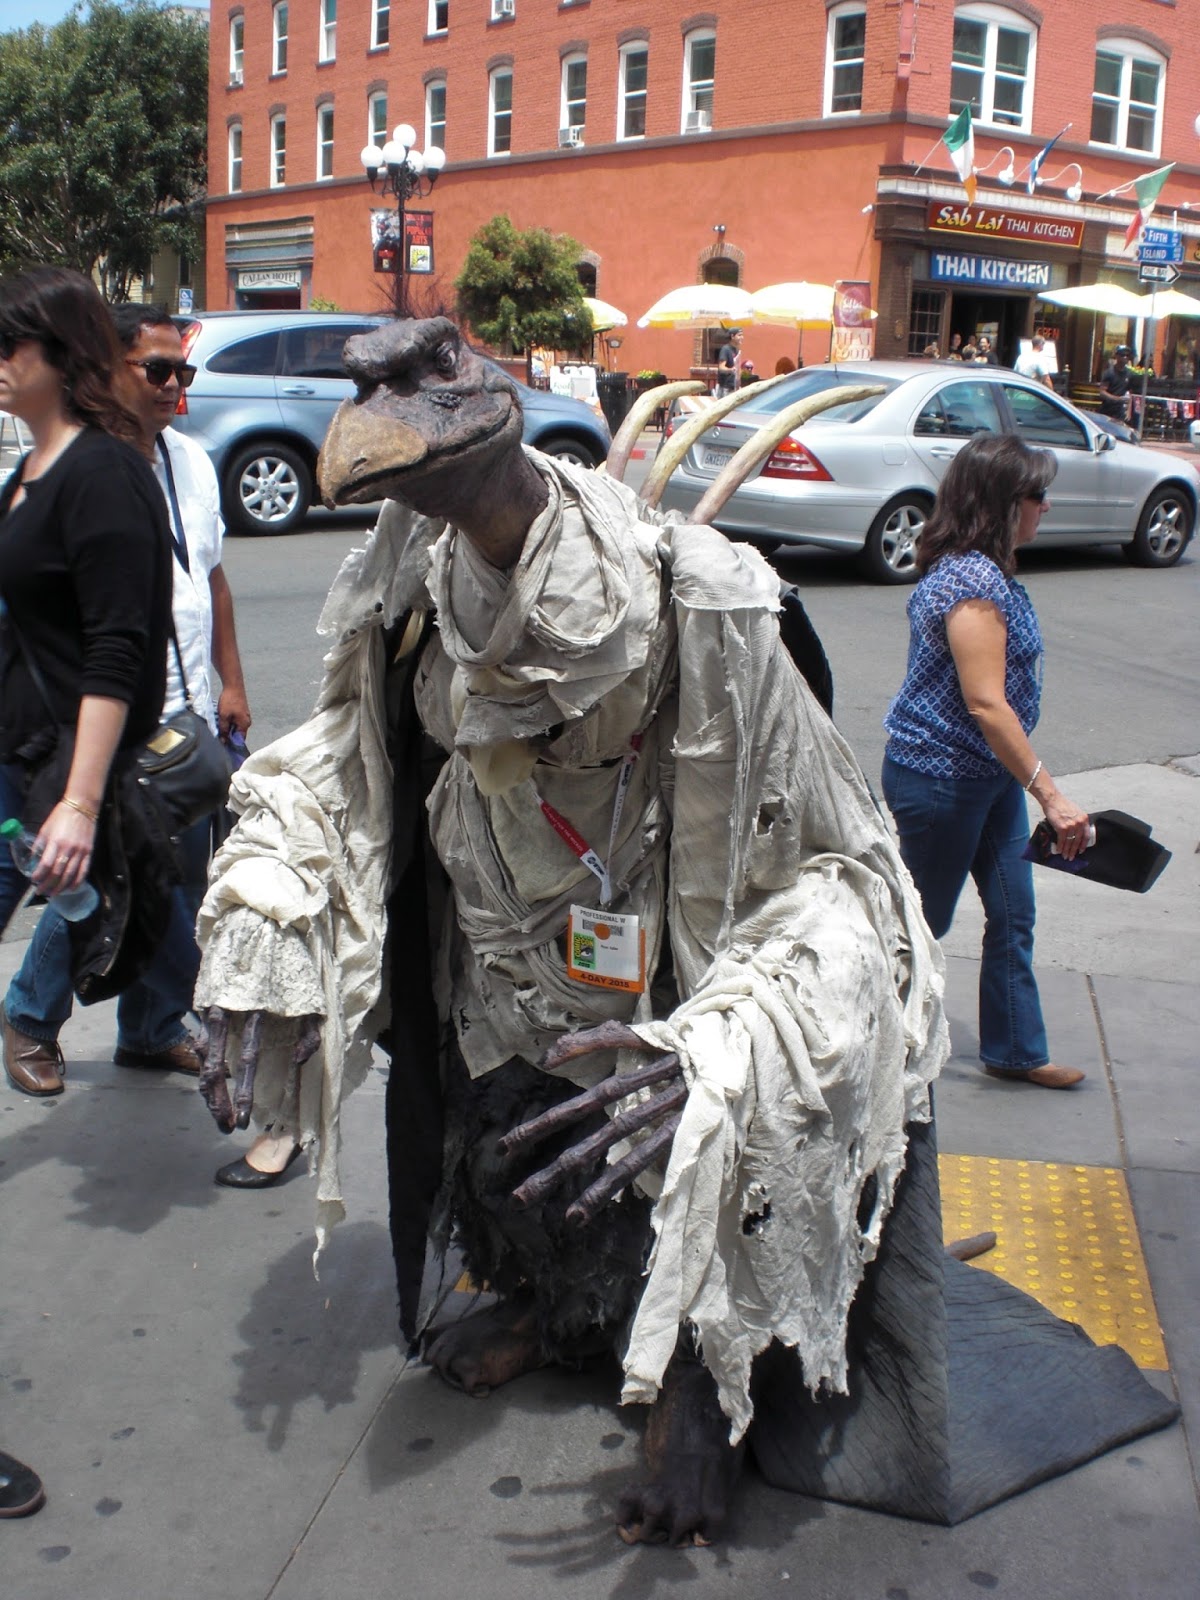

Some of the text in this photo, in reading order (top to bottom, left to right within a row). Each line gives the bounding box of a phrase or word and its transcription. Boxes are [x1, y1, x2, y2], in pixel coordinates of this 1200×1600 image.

[936, 205, 1075, 238] Sab Lai THAI KITCHEN
[1148, 229, 1168, 243] FIFTH
[1142, 247, 1167, 260] ISLAND
[936, 254, 1049, 286] THAI KITCHEN
[242, 271, 297, 286] CALLAN HOTEL
[835, 330, 870, 346] THAI
[580, 909, 618, 923] PROFESSIONAL
[580, 973, 630, 988] 4-DAY 2015
